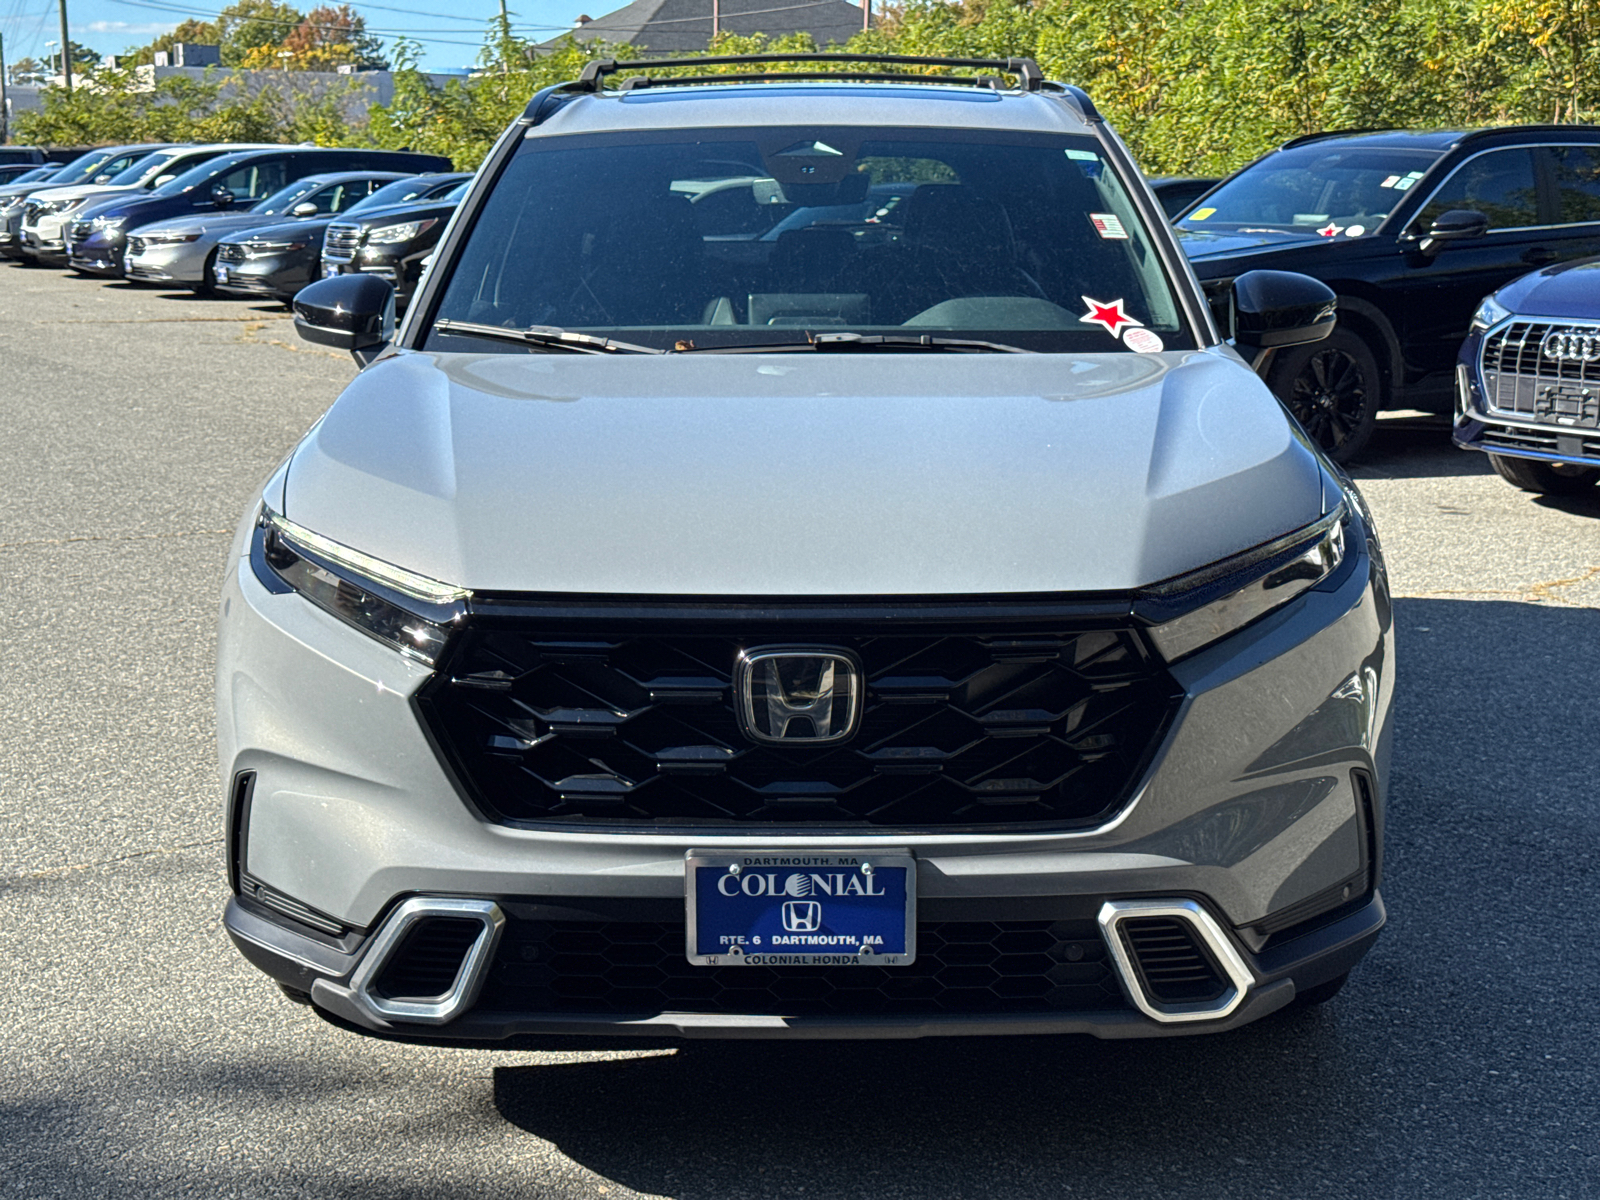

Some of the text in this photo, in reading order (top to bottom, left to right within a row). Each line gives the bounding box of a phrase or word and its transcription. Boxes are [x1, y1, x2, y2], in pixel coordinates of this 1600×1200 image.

[838, 857, 858, 865] MA
[717, 873, 885, 897] COLONIAL
[720, 935, 884, 947] RTE. 6 DARTMOUTH, MA
[744, 955, 860, 965] COLONIAL HONDA
